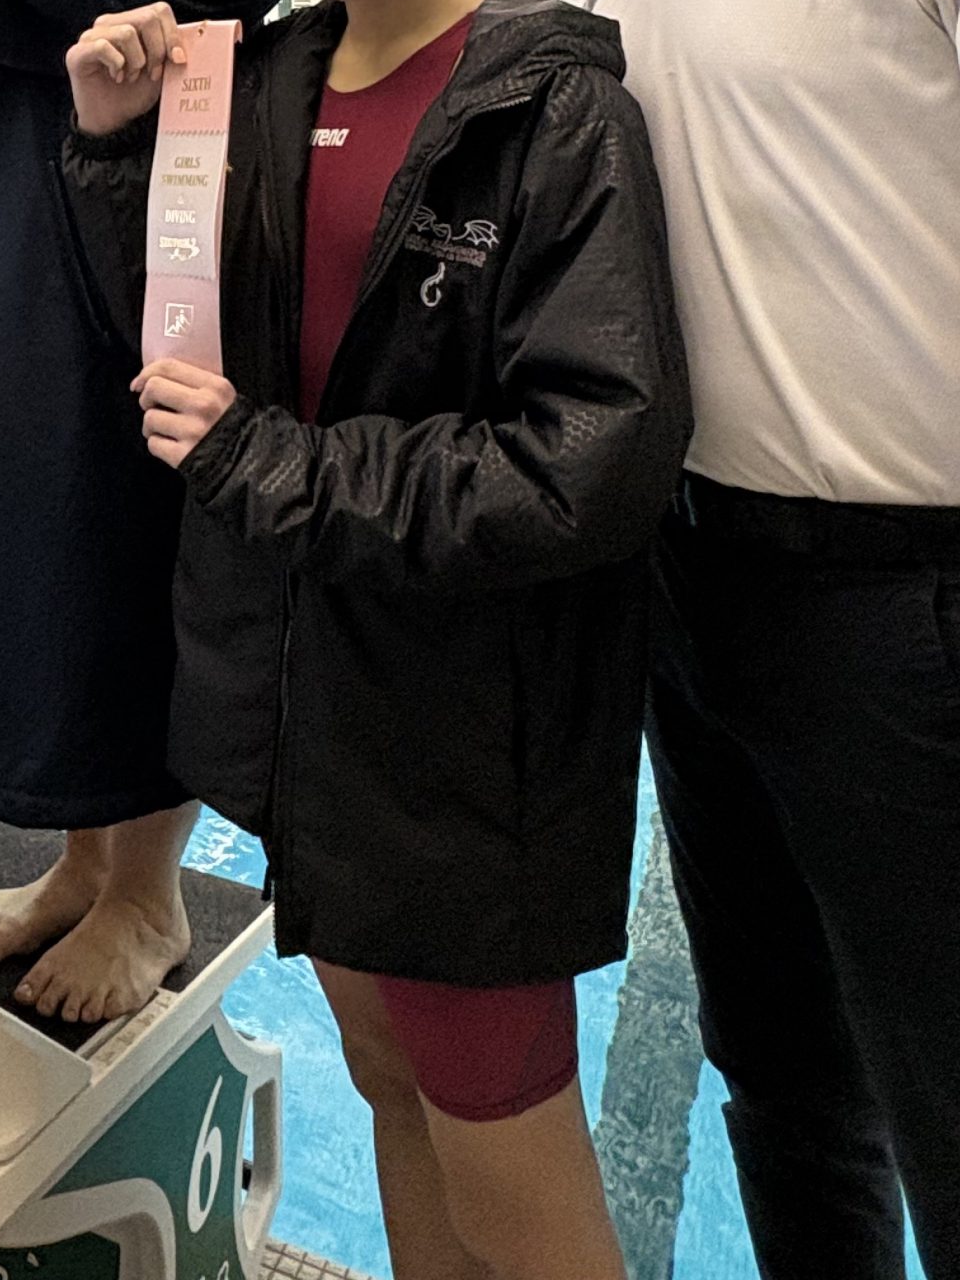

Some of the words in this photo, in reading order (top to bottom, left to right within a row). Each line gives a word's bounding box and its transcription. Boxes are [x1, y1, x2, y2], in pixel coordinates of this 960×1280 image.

[181, 76, 212, 92] SIXTH
[179, 98, 210, 113] PLACE
[309, 129, 350, 147] rena
[174, 156, 201, 169] GIRLS
[161, 173, 209, 188] SWIMMING
[164, 209, 197, 224] DIVING
[187, 1075, 223, 1234] 6
